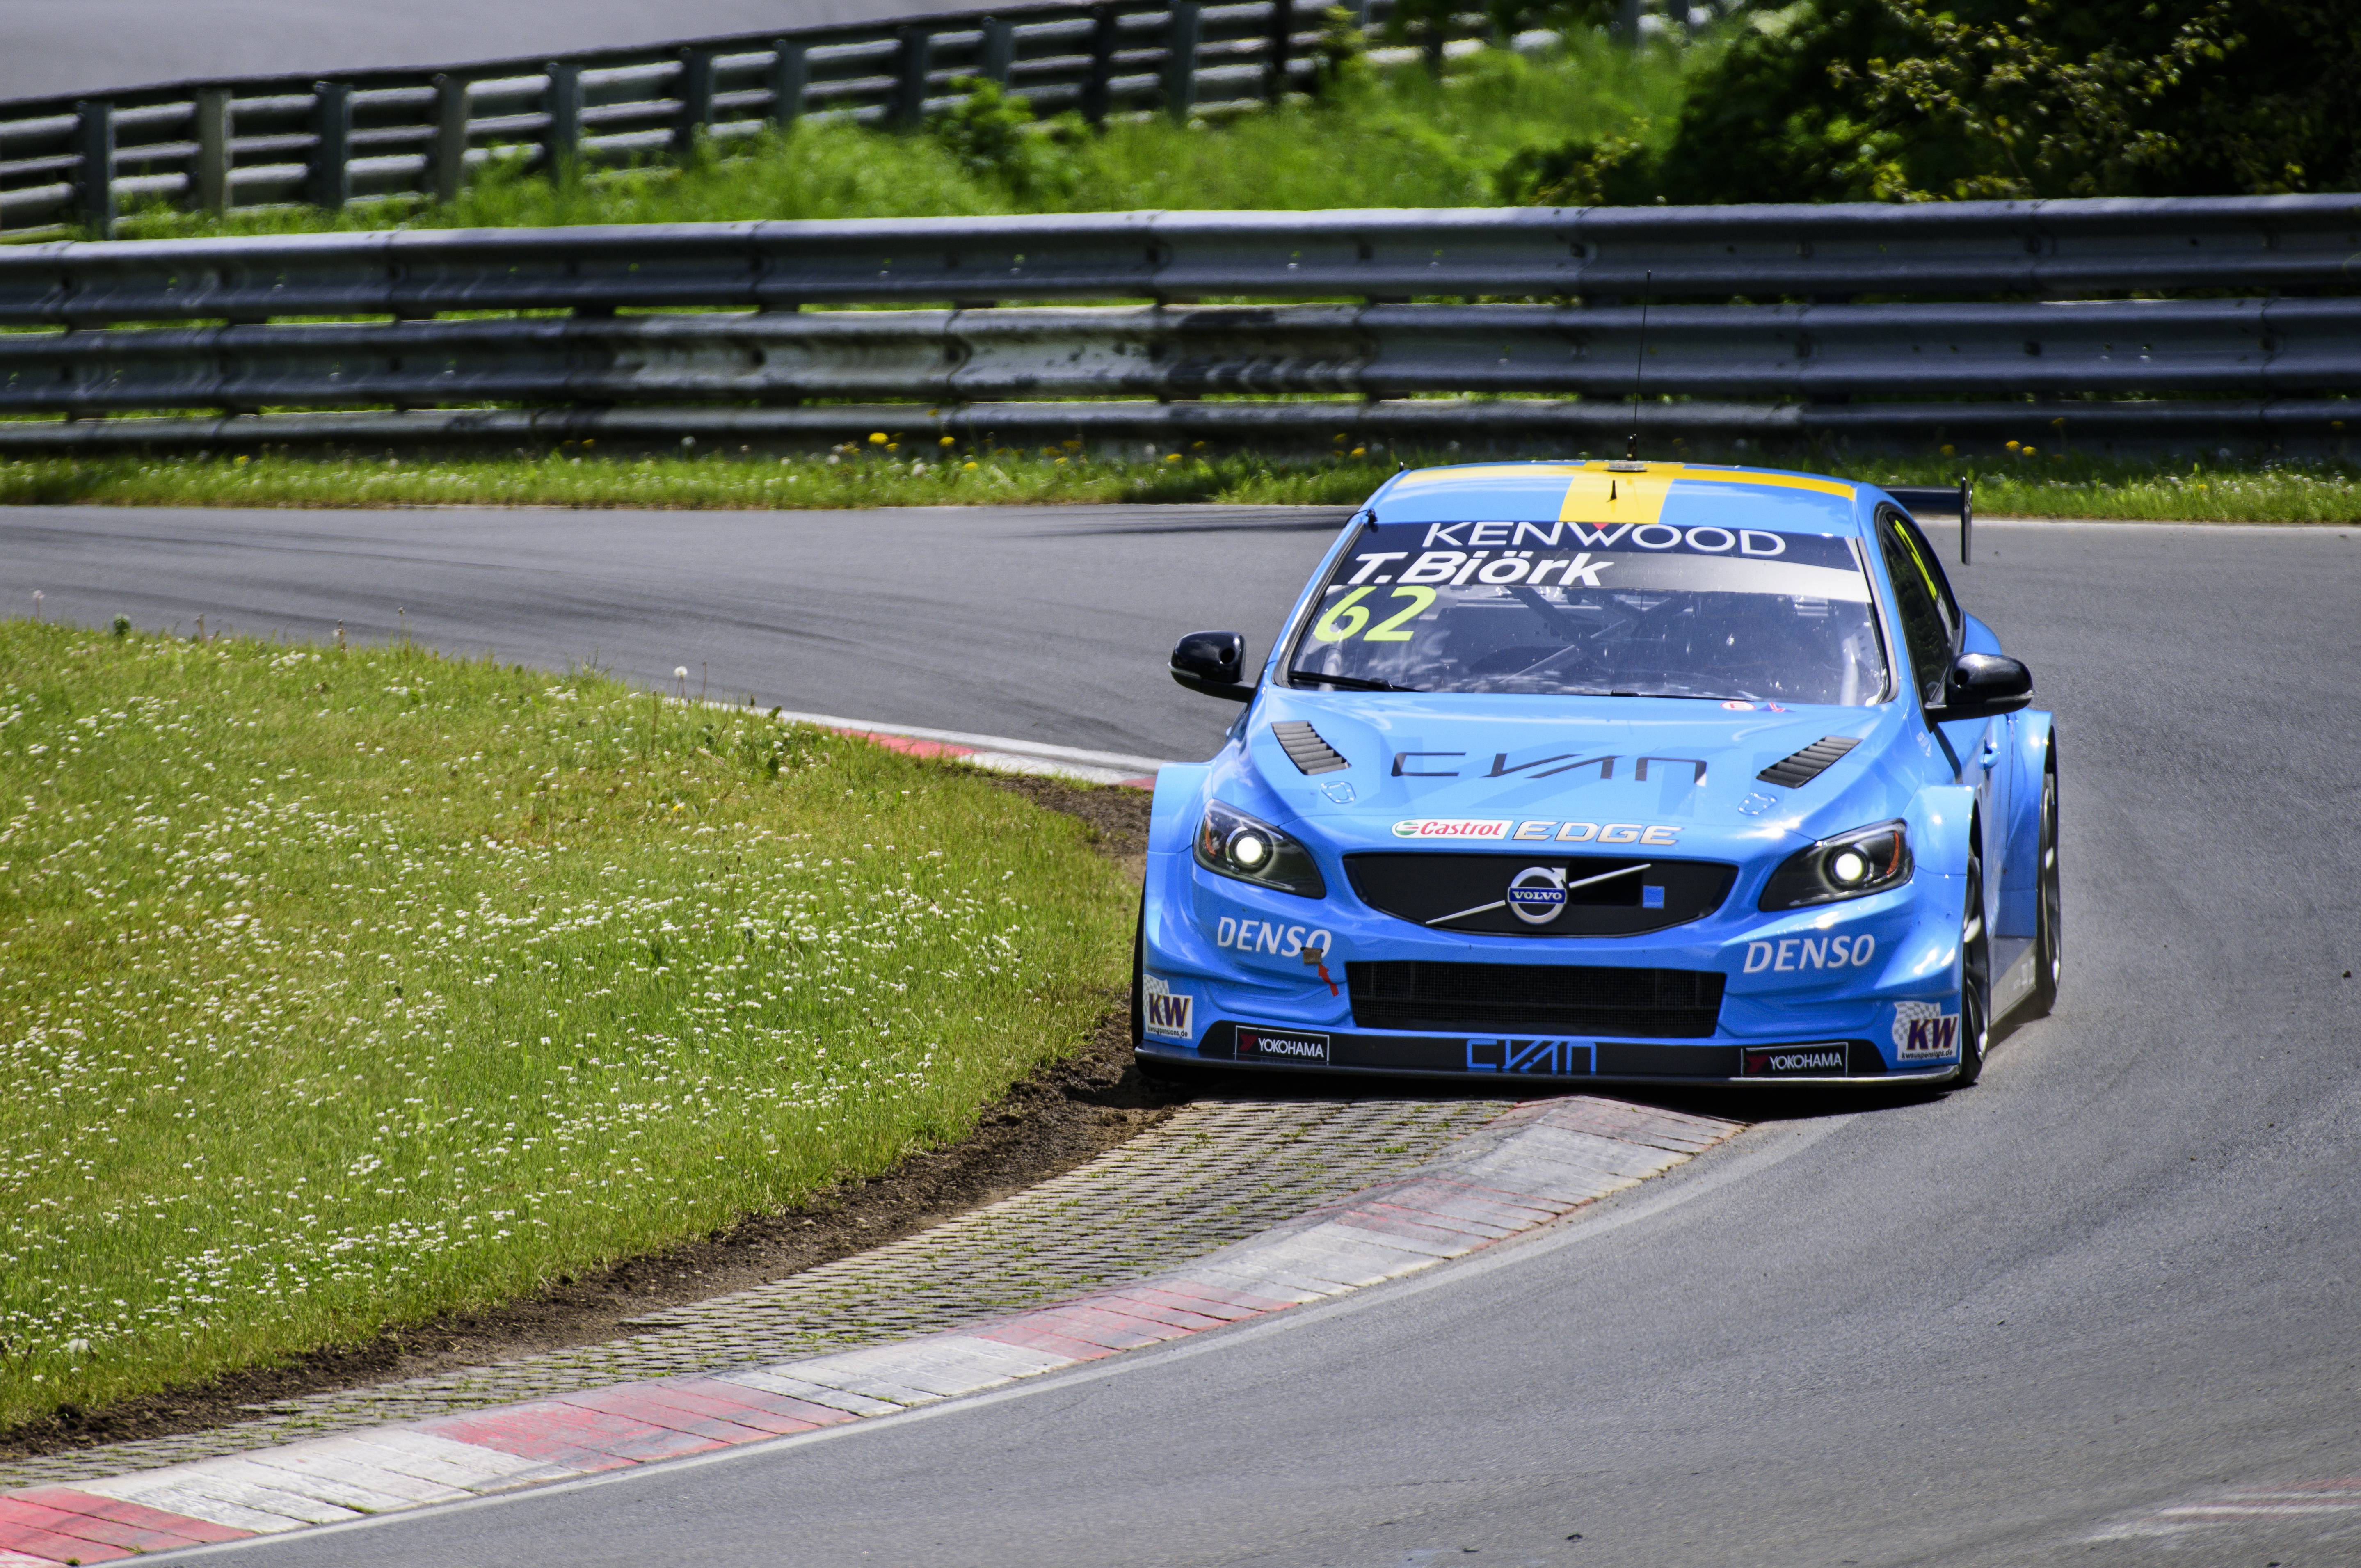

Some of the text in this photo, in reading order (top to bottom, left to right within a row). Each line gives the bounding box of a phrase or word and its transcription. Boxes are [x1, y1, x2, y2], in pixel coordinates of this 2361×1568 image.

[1422, 522, 1786, 557] KENWOOD
[1314, 586, 1437, 641] 62
[1420, 821, 1684, 845] Castrol EDGE
[1513, 891, 1562, 900] VOLVO
[1217, 917, 1332, 959] DENSO
[1743, 934, 1875, 973] DENSO
[1149, 993, 1191, 1029] KW
[1258, 1038, 1324, 1058] YOKOHAMA
[1906, 1017, 1958, 1050] KW
[1769, 1052, 1843, 1070] YOKOHAMA
